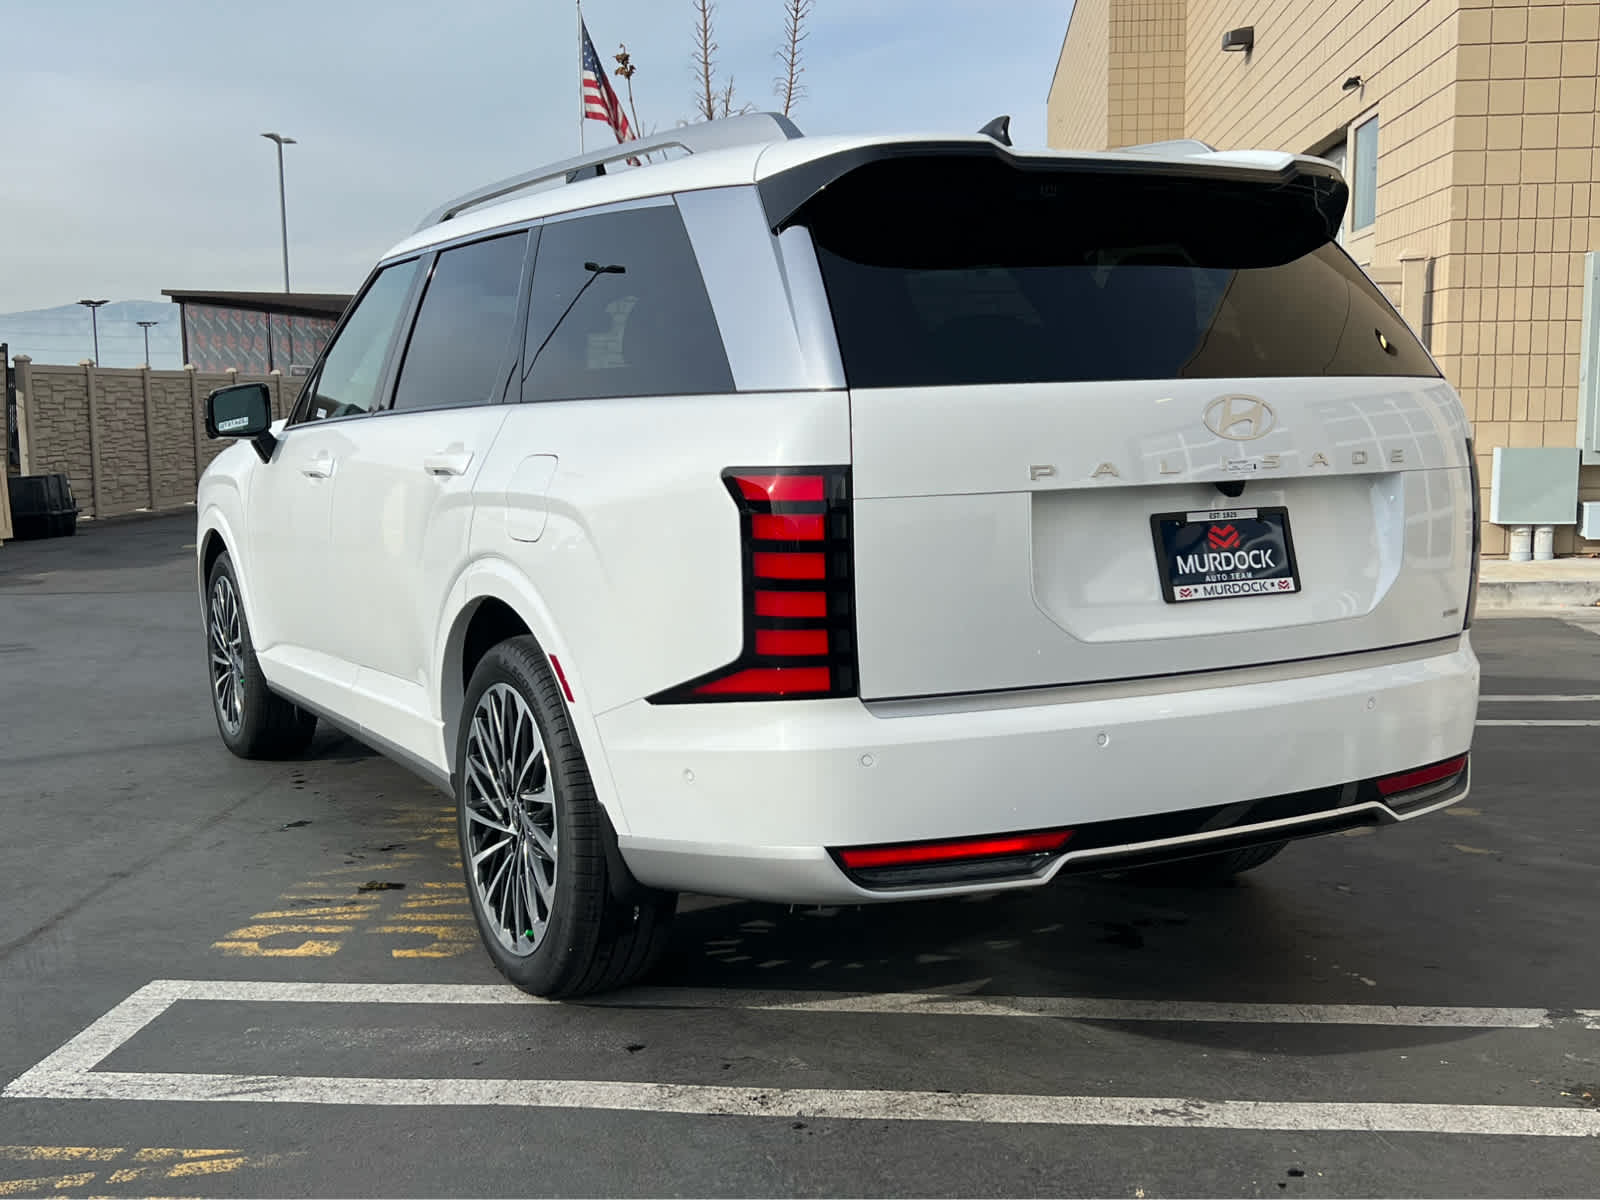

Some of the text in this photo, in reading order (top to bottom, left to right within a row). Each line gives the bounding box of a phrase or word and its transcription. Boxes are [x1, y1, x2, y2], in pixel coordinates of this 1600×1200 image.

[1029, 449, 1405, 481] PALISADE
[1176, 549, 1275, 574] MURDOCK
[1205, 572, 1253, 582] AUTO TEAM
[1203, 581, 1268, 597] MURDOCK
